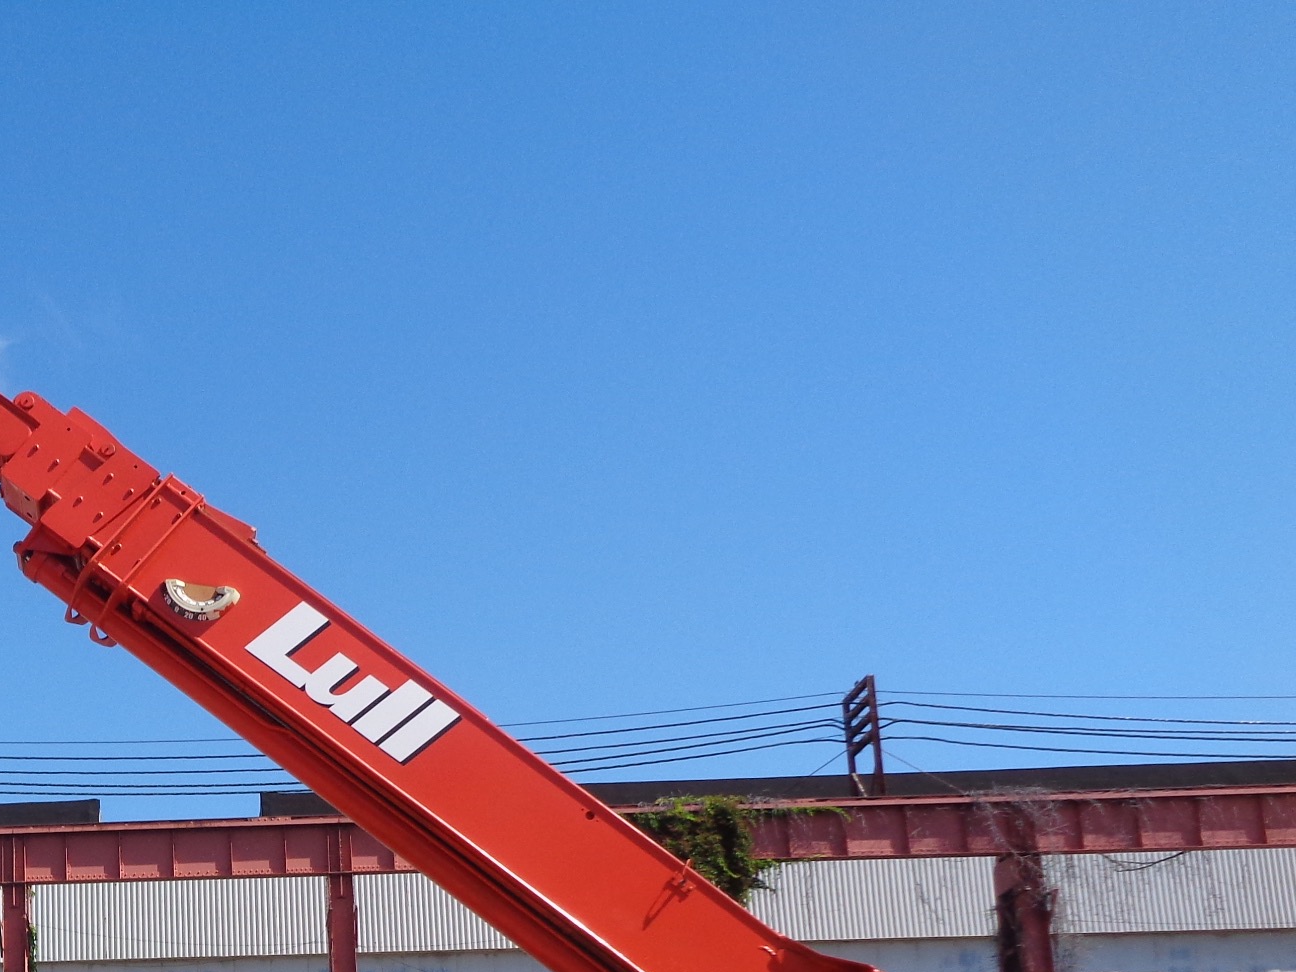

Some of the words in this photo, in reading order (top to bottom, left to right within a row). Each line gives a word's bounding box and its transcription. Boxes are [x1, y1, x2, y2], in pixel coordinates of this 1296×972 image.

[184, 611, 194, 620] 20
[197, 613, 207, 621] 40
[244, 600, 462, 766] Lull
